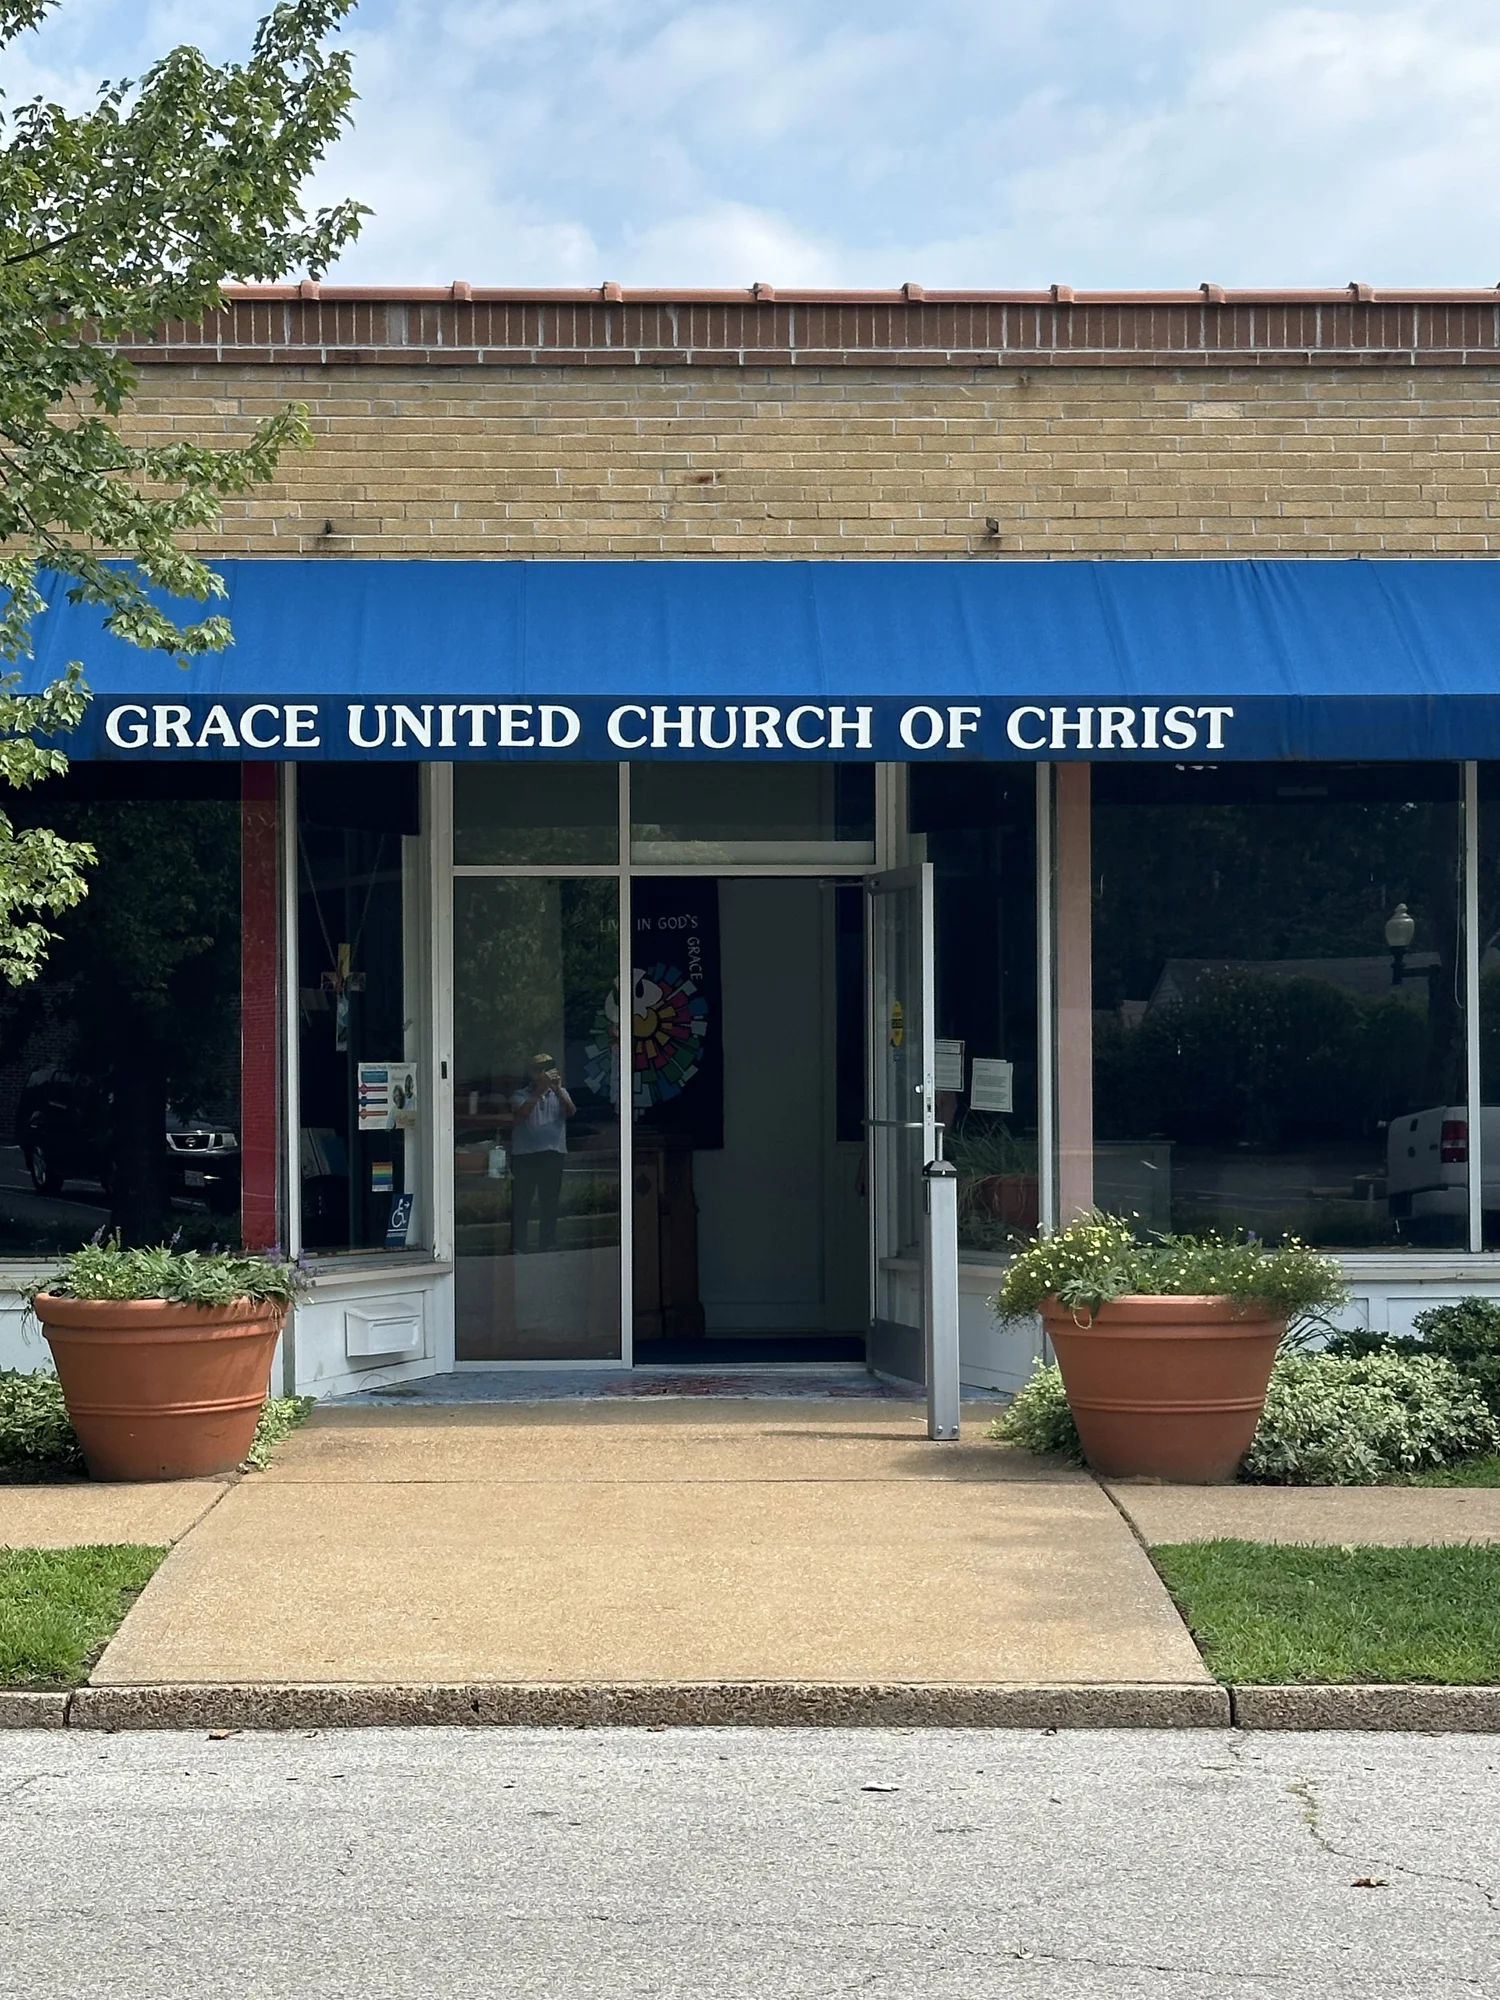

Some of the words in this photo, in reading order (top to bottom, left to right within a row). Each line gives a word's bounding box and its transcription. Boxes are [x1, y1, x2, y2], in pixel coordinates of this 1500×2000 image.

[105, 704, 321, 749] GRACE
[347, 704, 581, 748] UNITED
[607, 704, 873, 749] CHURCH
[899, 705, 982, 750] OF
[1006, 705, 1234, 750] CHRIST
[600, 920, 619, 932] LIV
[637, 918, 651, 930] IN
[658, 914, 698, 929] GOD'S
[687, 937, 703, 980] GRACE
